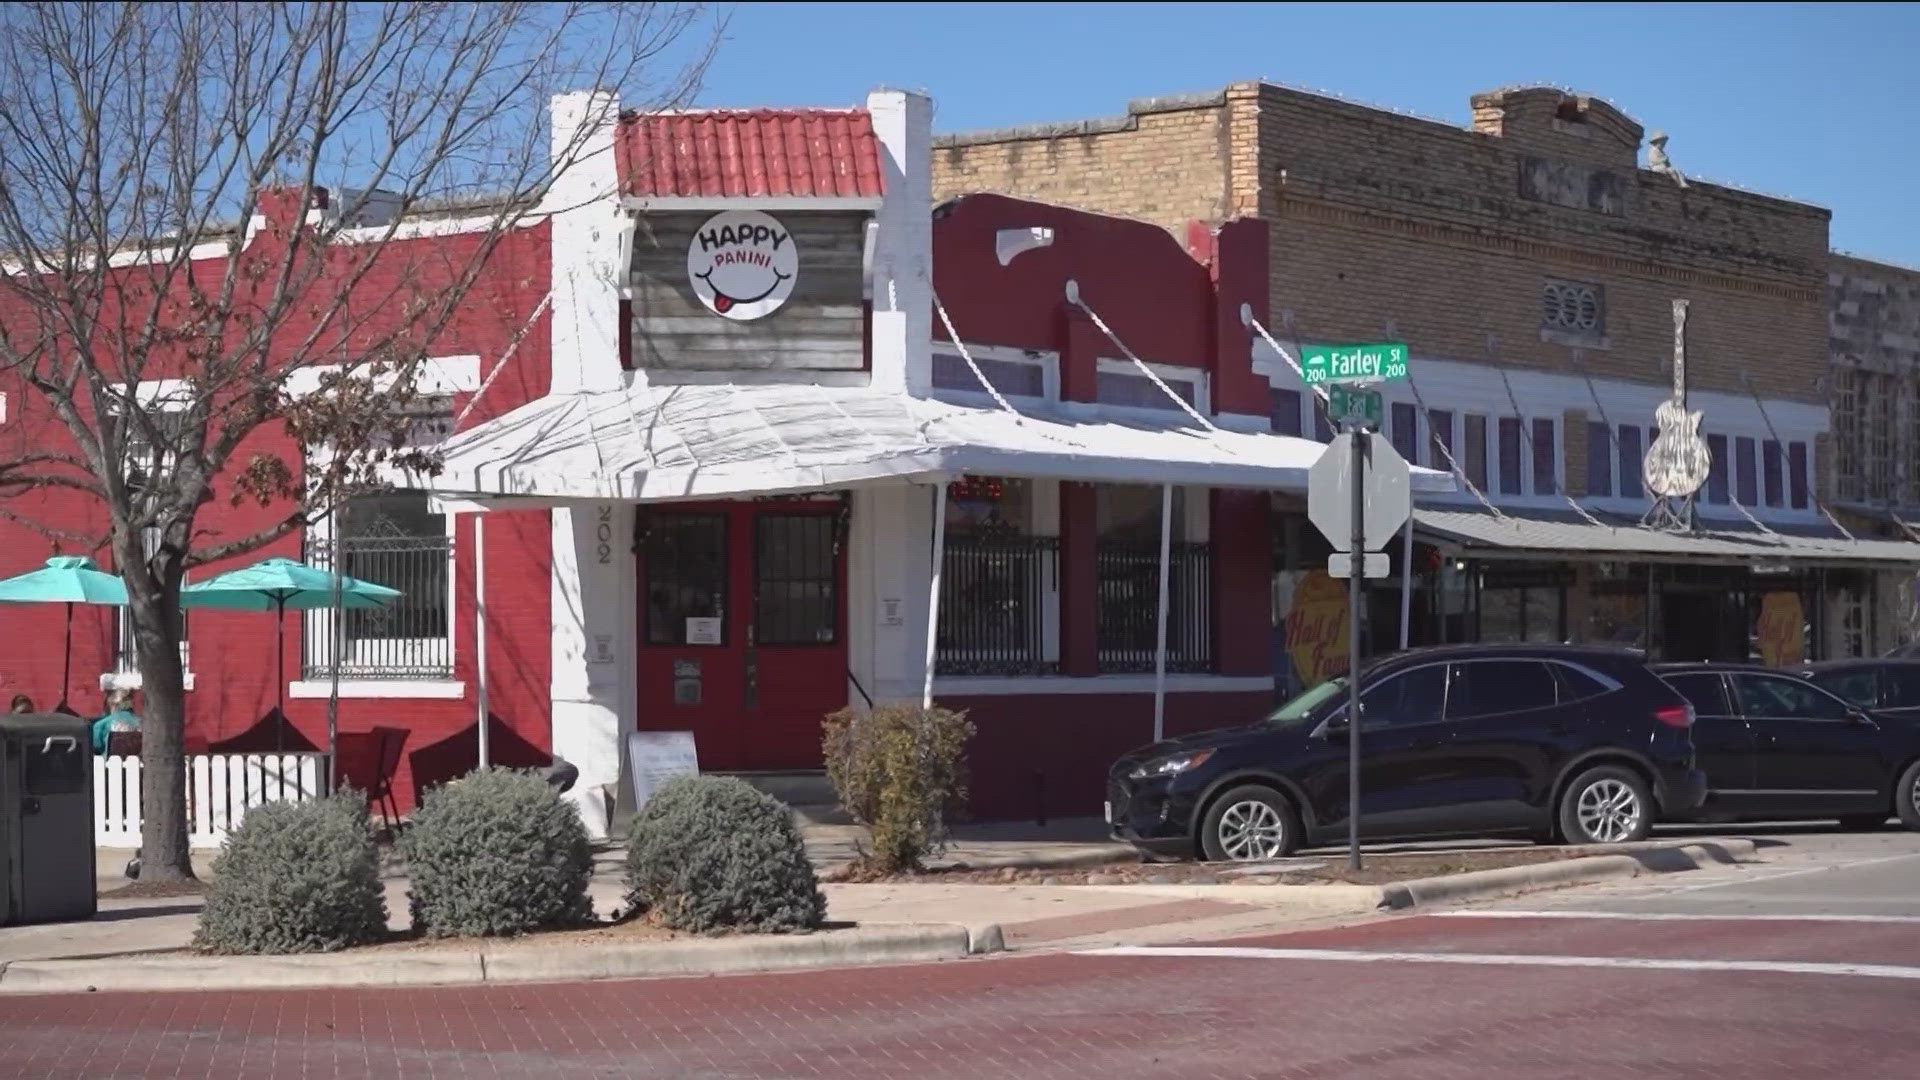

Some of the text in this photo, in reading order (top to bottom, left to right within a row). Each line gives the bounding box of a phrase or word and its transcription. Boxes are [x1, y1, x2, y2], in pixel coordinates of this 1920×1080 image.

[699, 223, 787, 252] HAPPY
[714, 250, 772, 268] PANINI
[1306, 369, 1326, 382] 200
[1331, 348, 1401, 376] Farley St
[1385, 363, 1406, 378] 200
[597, 505, 612, 564] 202
[1286, 608, 1346, 648] Hall of
[1311, 641, 1351, 680] Fam
